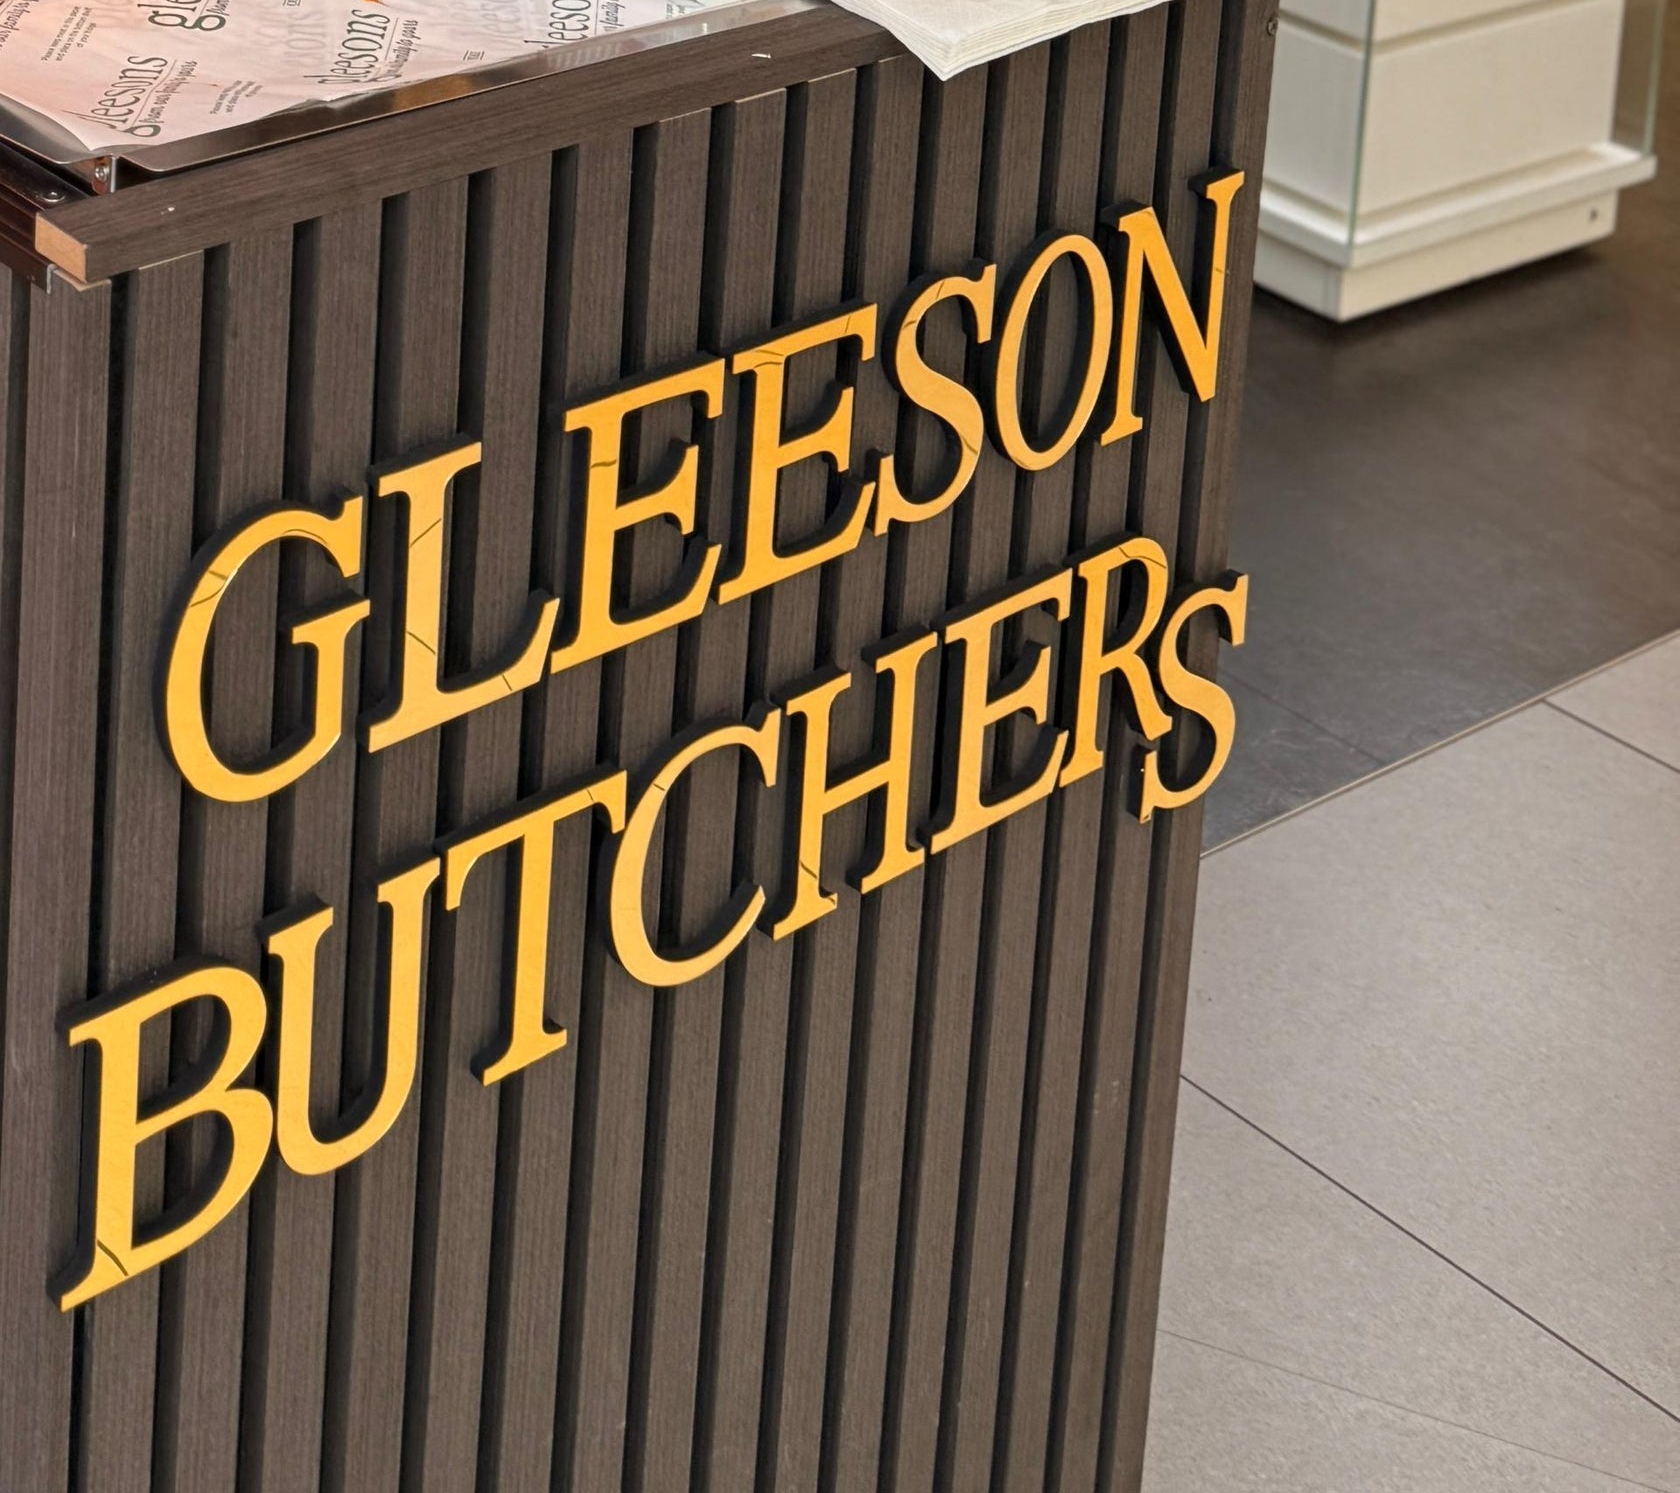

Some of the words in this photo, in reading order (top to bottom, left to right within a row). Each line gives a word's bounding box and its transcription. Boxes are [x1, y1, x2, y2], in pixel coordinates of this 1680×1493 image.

[304, 9, 391, 84] leesons
[165, 170, 1245, 803] GLEESON
[62, 535, 1249, 1310] BUTCHERS
